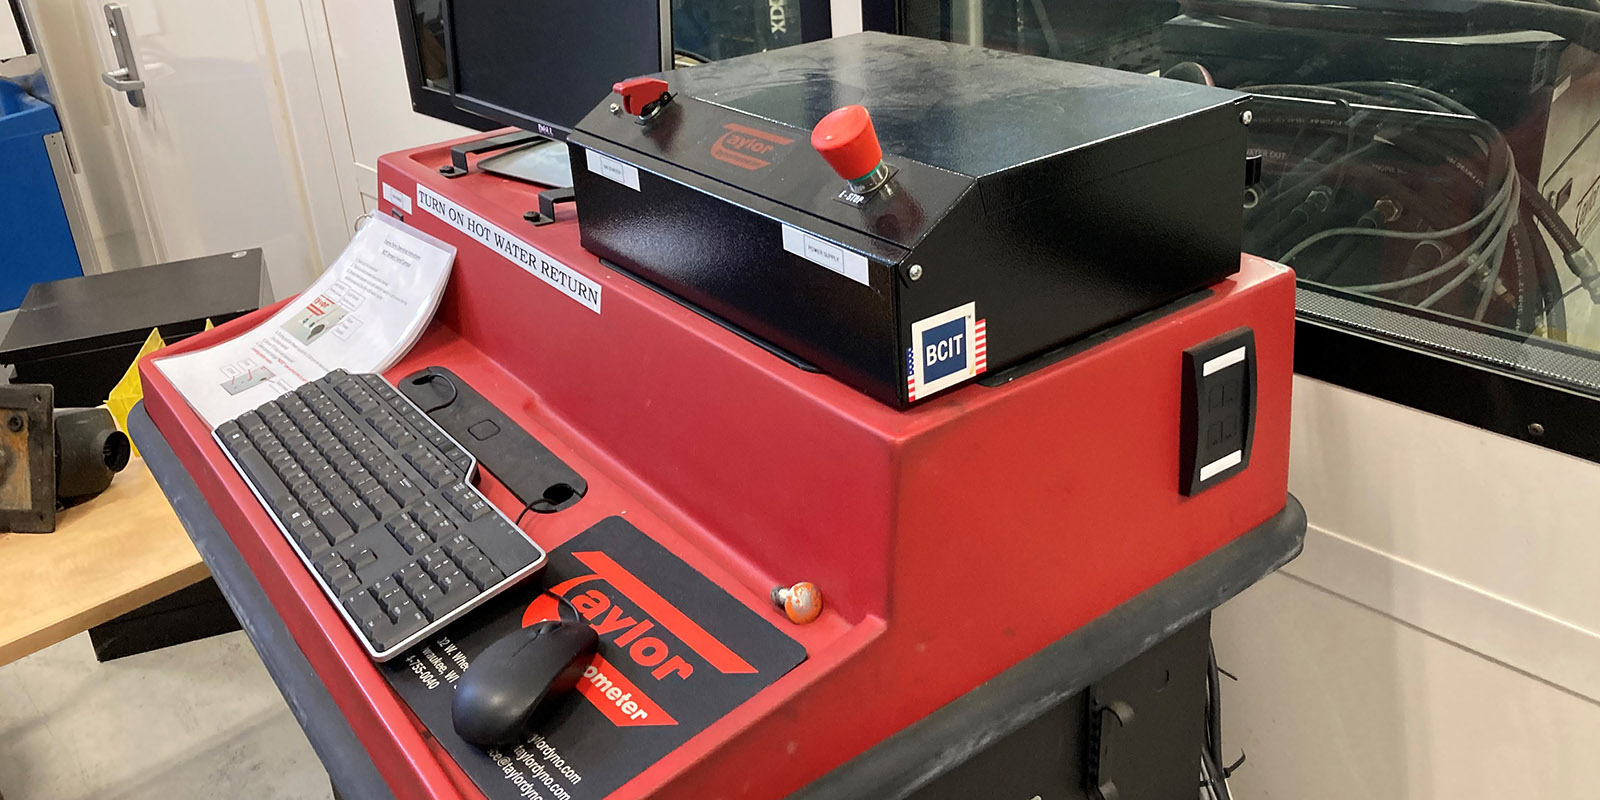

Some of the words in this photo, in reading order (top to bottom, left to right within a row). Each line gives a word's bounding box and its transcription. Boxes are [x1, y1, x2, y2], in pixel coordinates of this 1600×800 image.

[838, 190, 865, 204] E-STOP
[418, 190, 446, 216] TURN
[448, 207, 465, 224] ON
[467, 218, 491, 242] HOT
[494, 233, 537, 270] WATER
[540, 260, 599, 306] RETURN
[926, 333, 964, 367] BCIT
[406, 655, 440, 689] 4-755-0040
[423, 647, 448, 675] waukee,
[583, 665, 648, 720] ometer
[488, 749, 544, 800] ce@taylordyno
[527, 733, 582, 785] ylordyno.com
